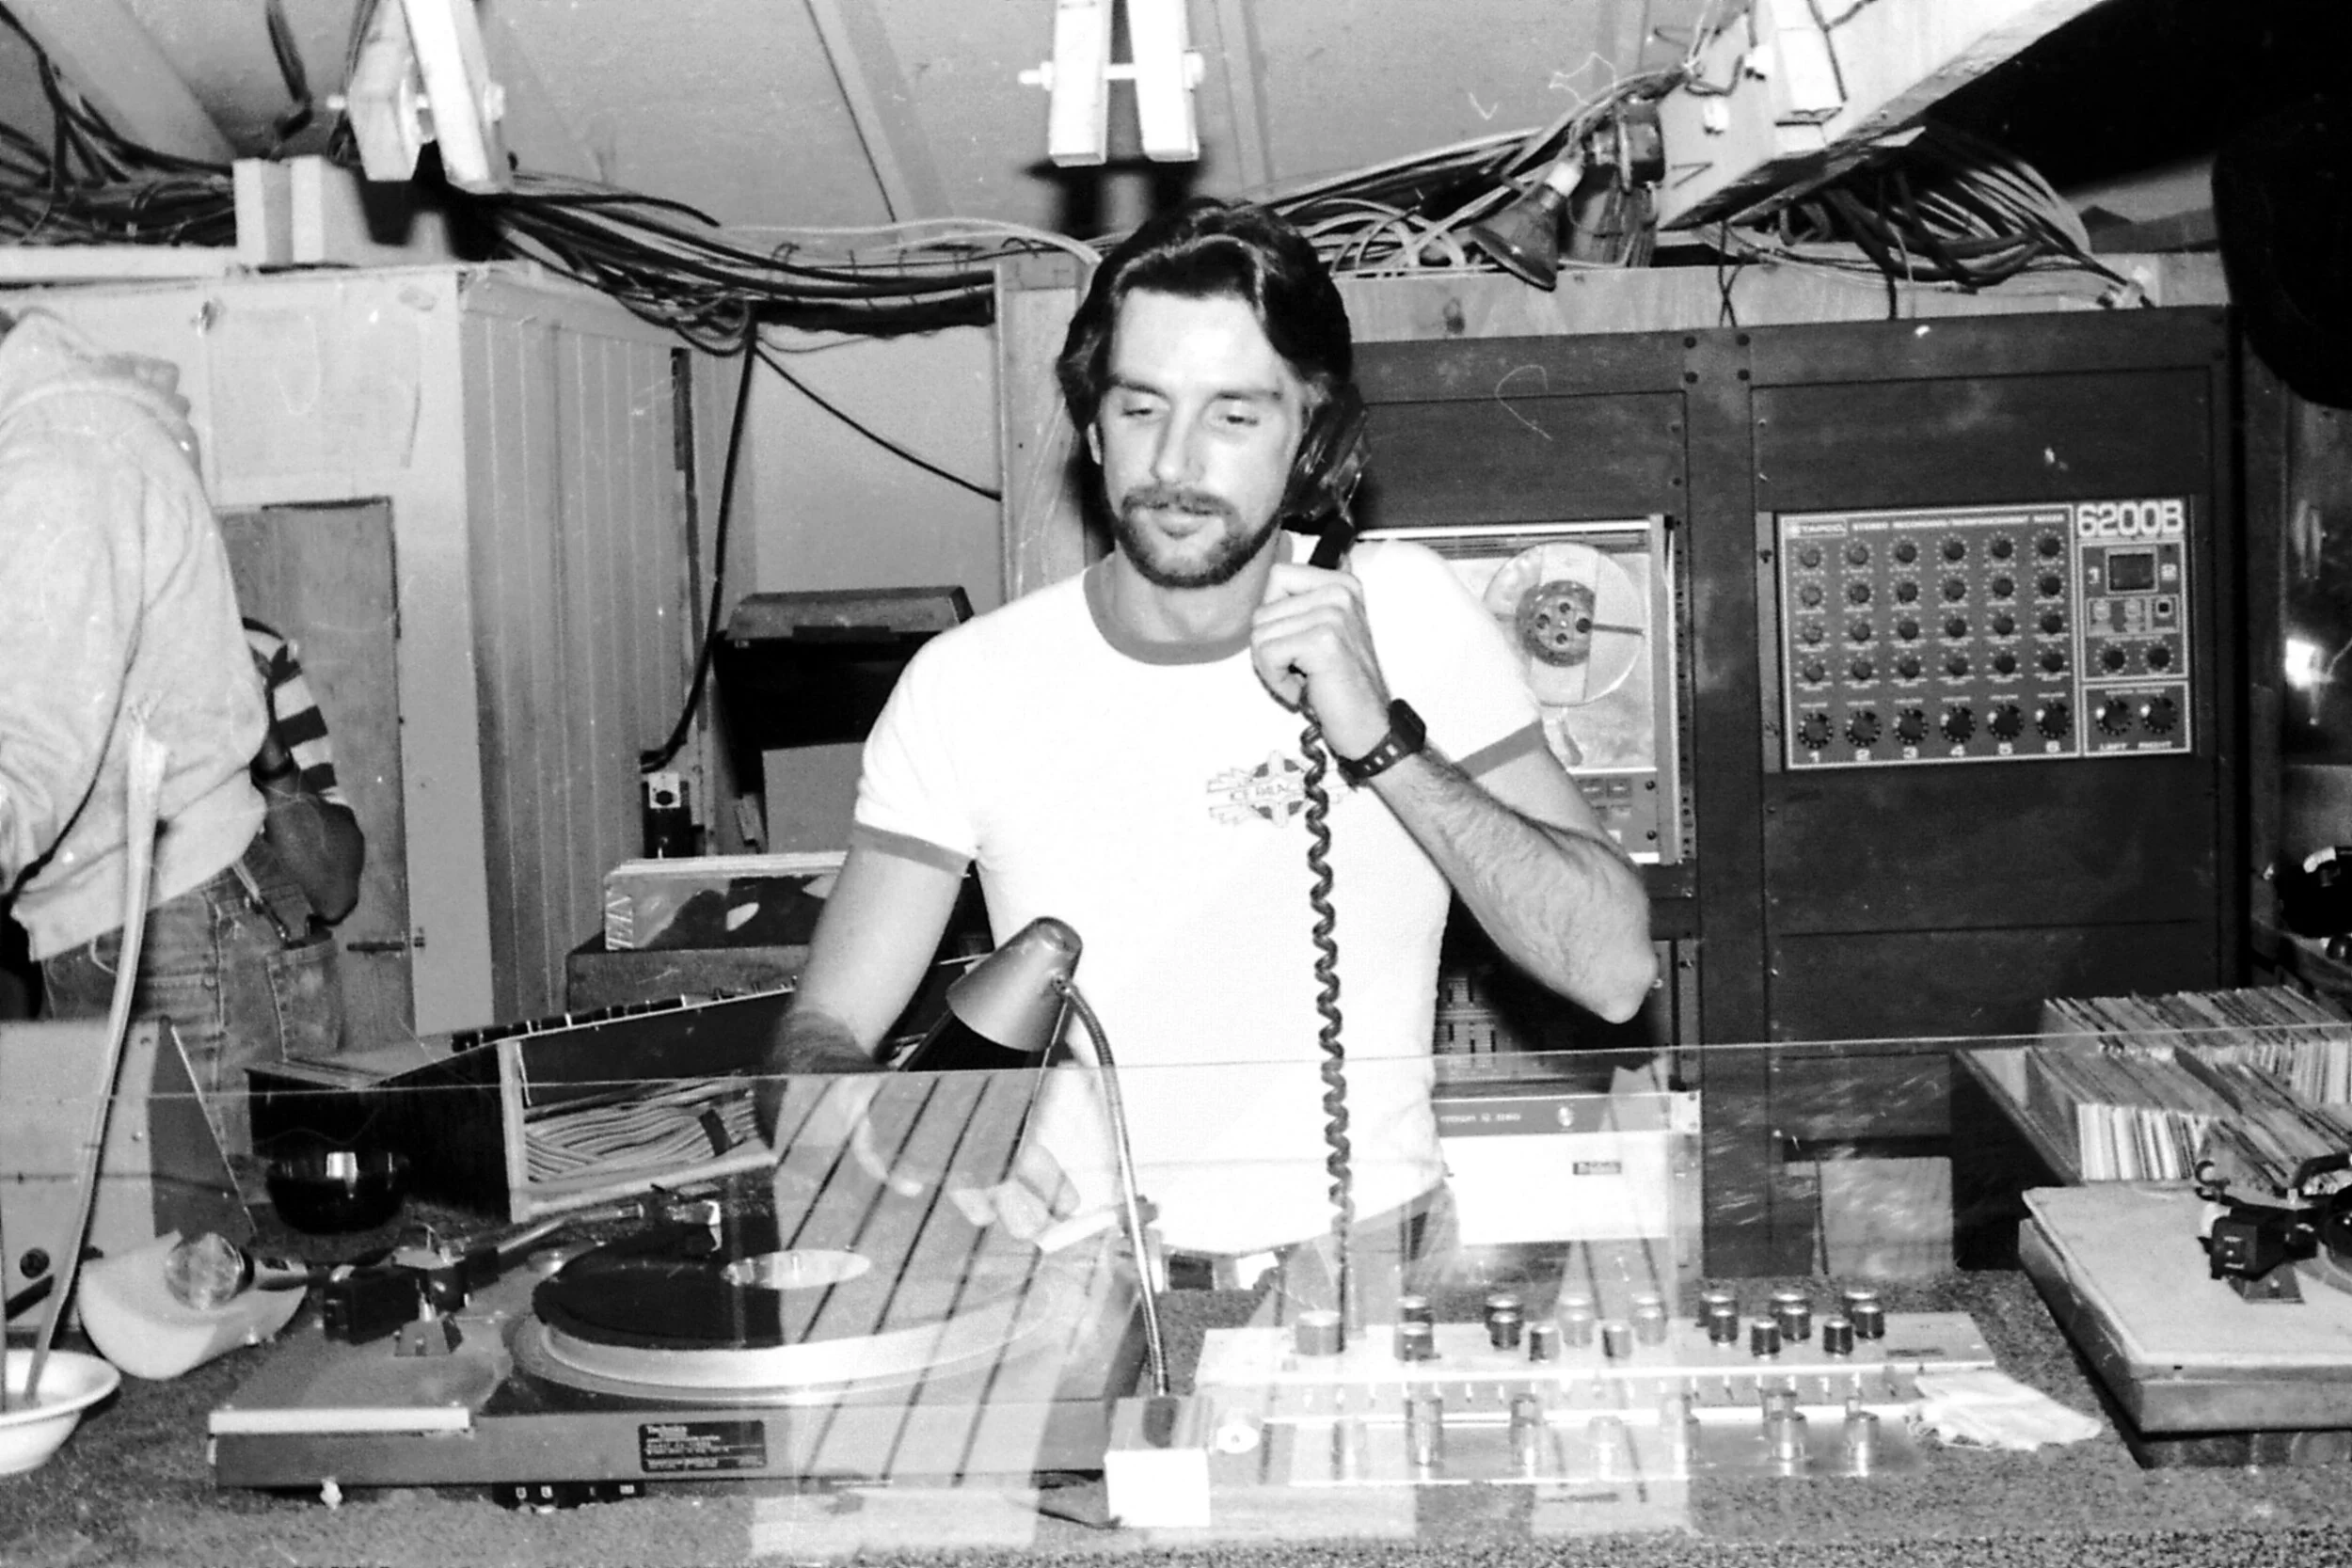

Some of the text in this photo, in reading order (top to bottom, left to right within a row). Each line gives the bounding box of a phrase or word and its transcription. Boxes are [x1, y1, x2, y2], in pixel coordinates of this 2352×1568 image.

[2077, 499, 2184, 537] 6200B
[1902, 746, 1918, 759] 3
[1950, 744, 1965, 757] 4
